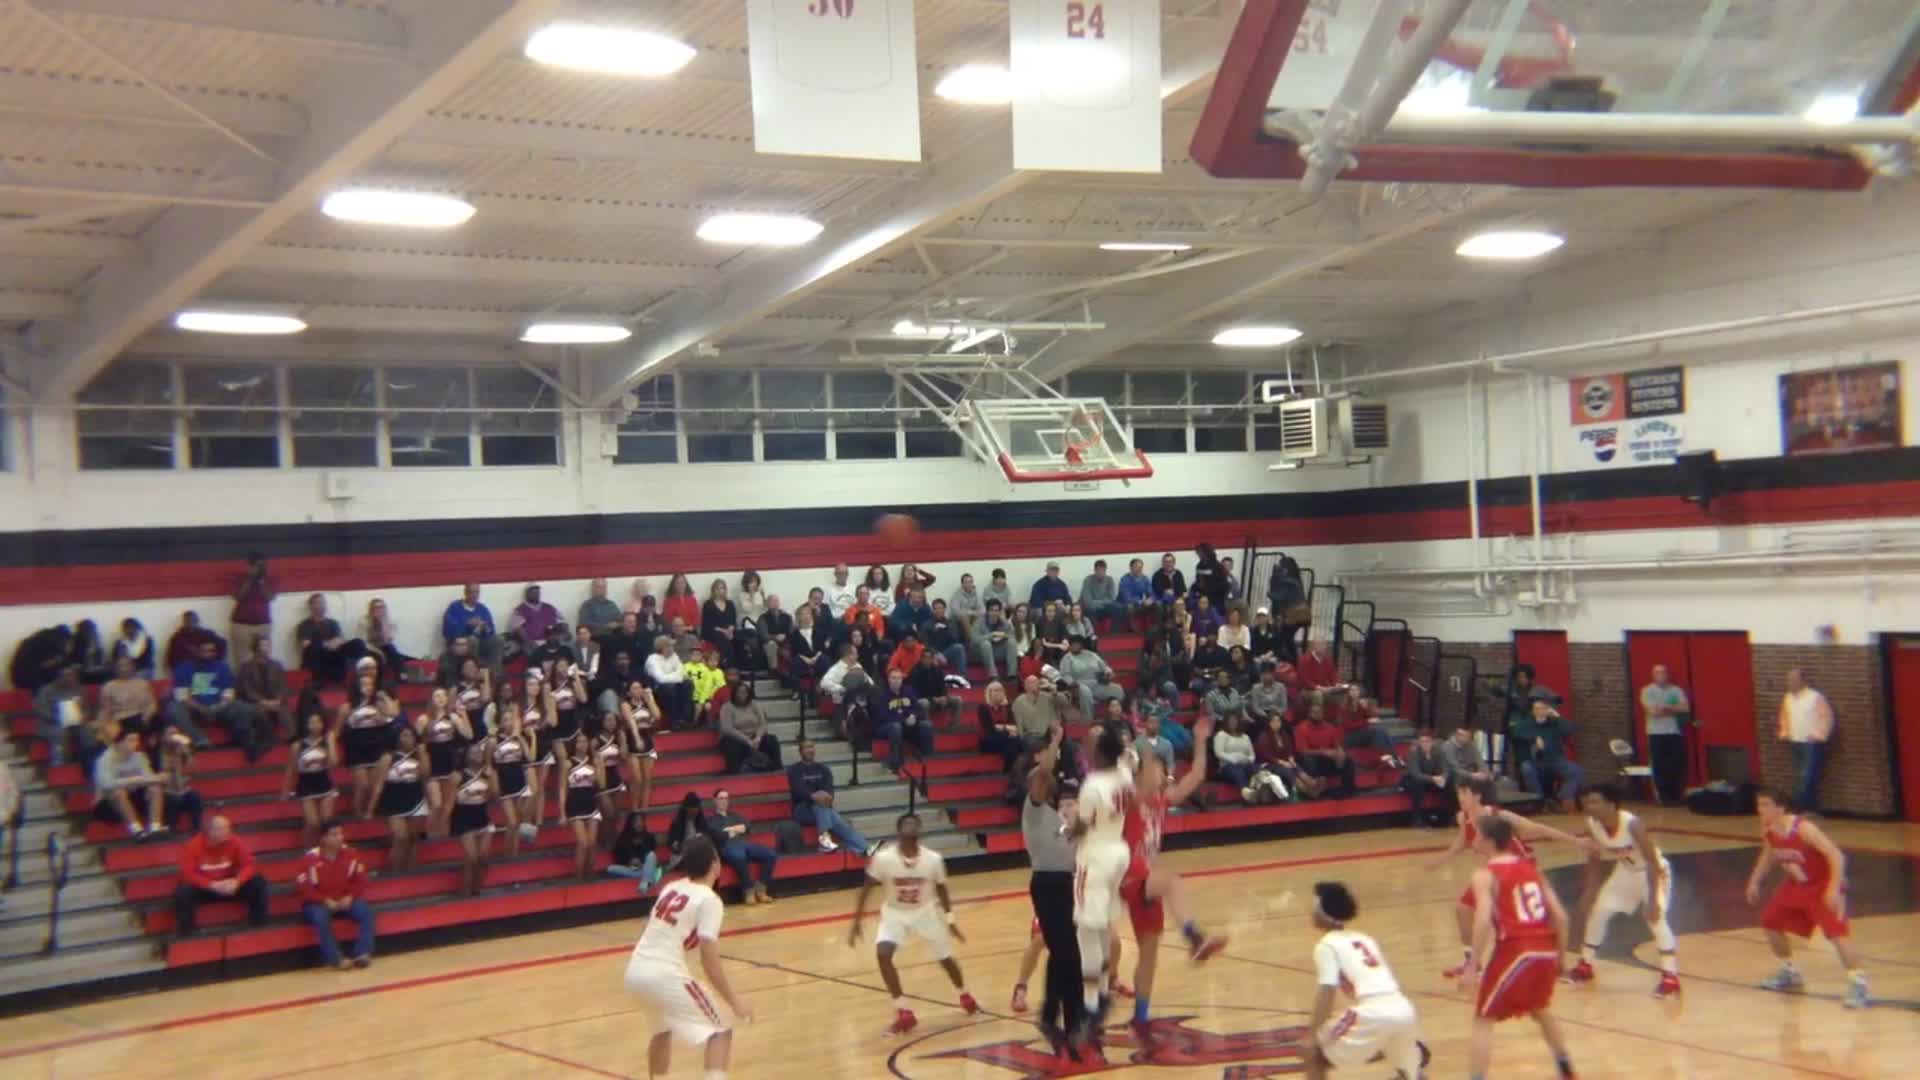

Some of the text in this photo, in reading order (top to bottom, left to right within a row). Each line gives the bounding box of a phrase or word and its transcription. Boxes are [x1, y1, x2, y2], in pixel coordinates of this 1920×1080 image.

[1067, 3, 1104, 39] 24
[655, 890, 690, 927] 42
[1513, 881, 1545, 921] 12
[1351, 940, 1380, 968] 3
